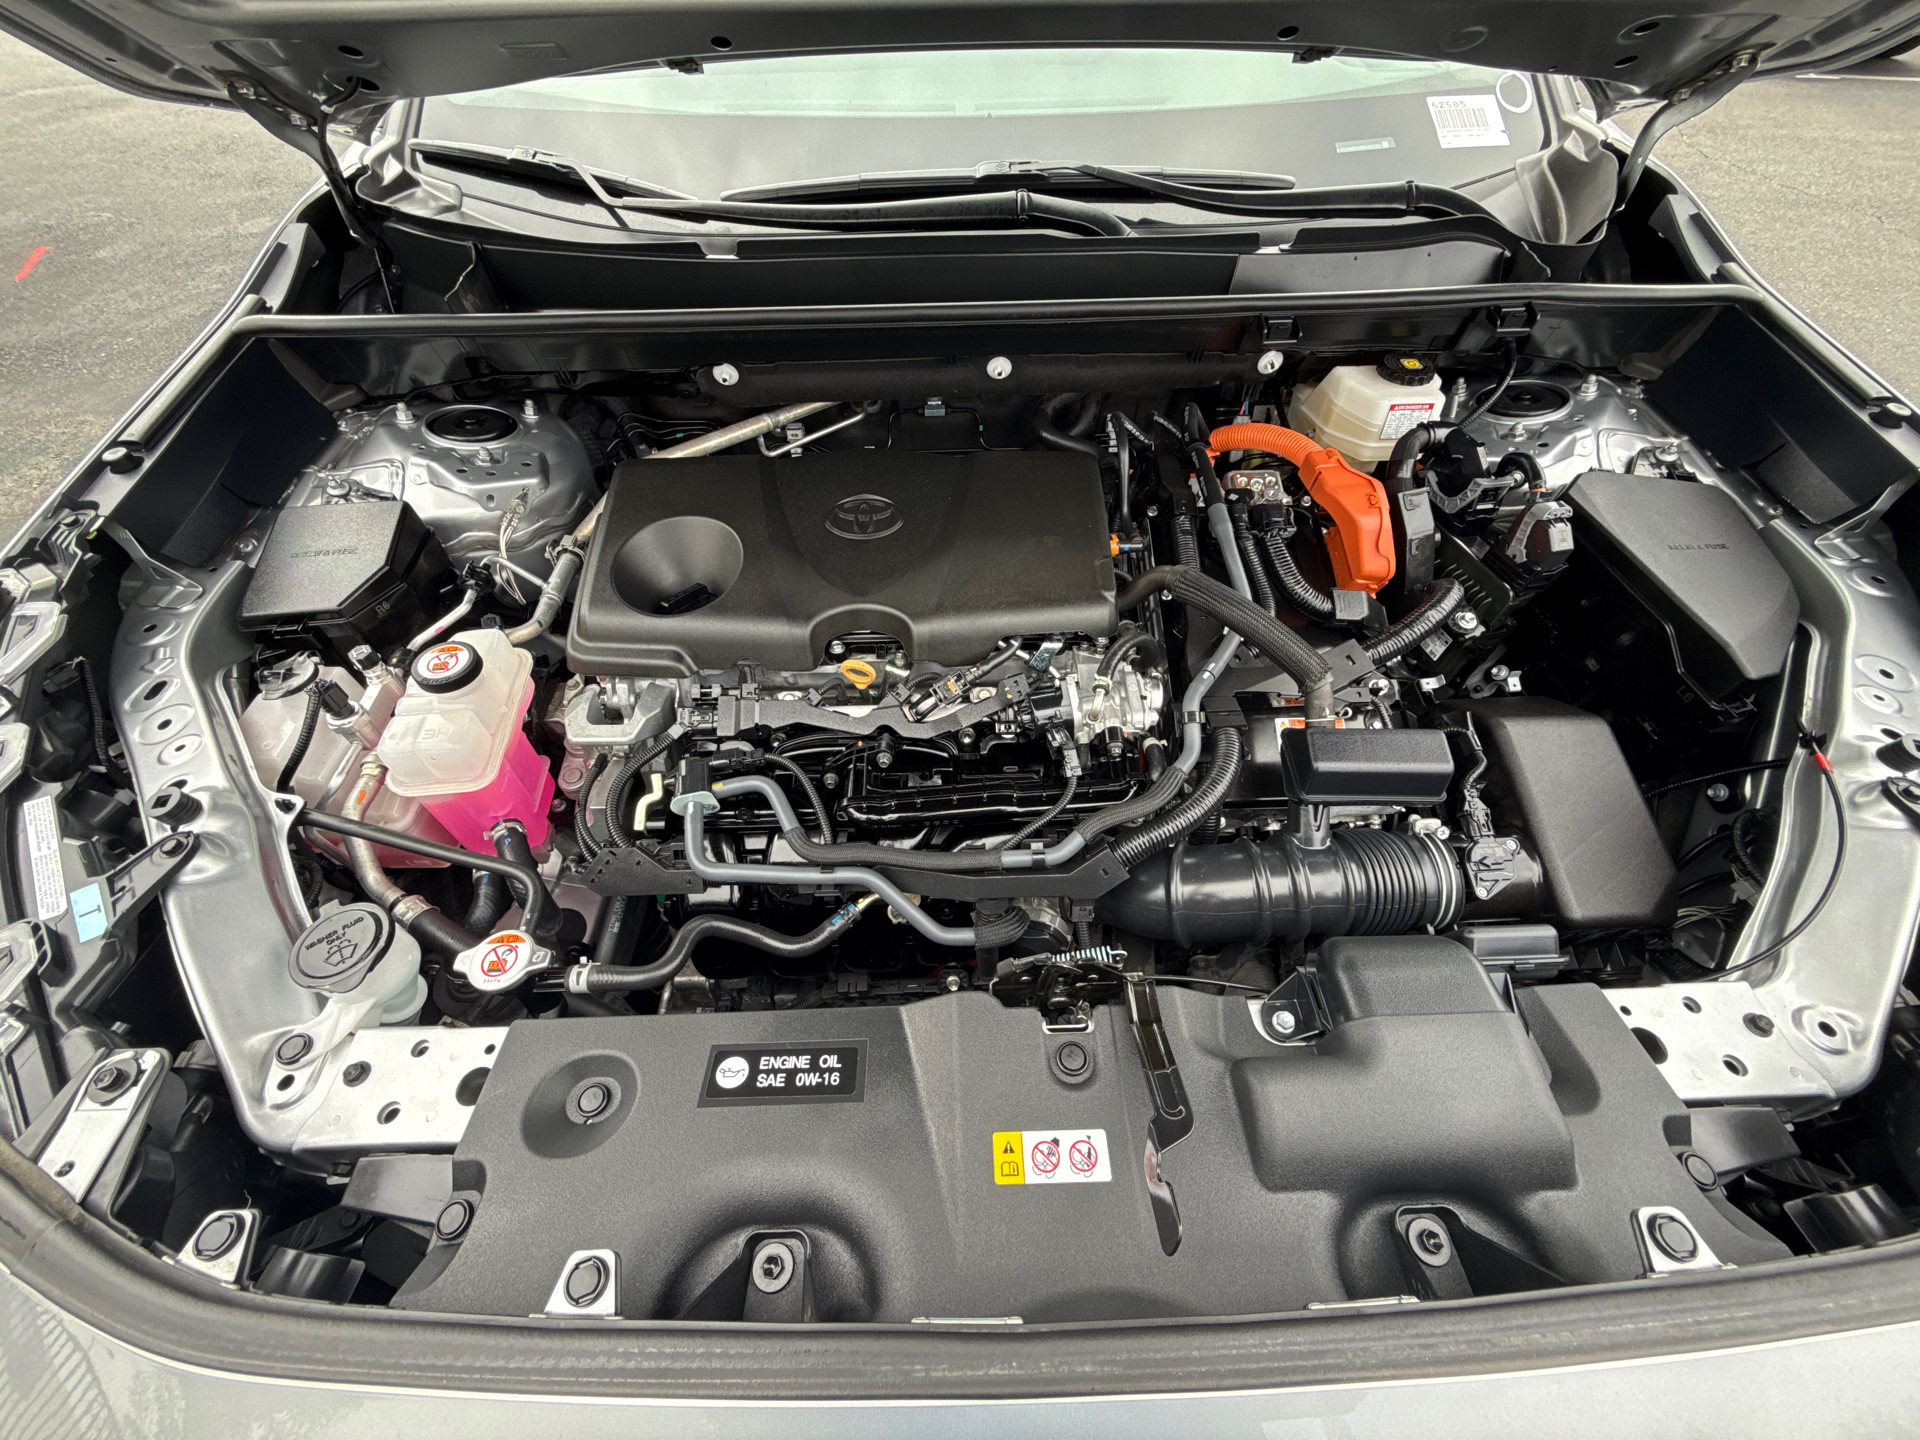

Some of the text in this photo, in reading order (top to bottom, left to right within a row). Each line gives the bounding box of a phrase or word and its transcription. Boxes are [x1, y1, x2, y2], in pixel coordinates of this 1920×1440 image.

[375, 601, 391, 617] R6
[1676, 685, 1695, 703] L6
[304, 916, 364, 951] WASHER FLUID
[326, 932, 347, 945] ONLY
[759, 1054, 842, 1070] ENGINE OIL
[756, 1071, 840, 1087] SAE 0W-16
